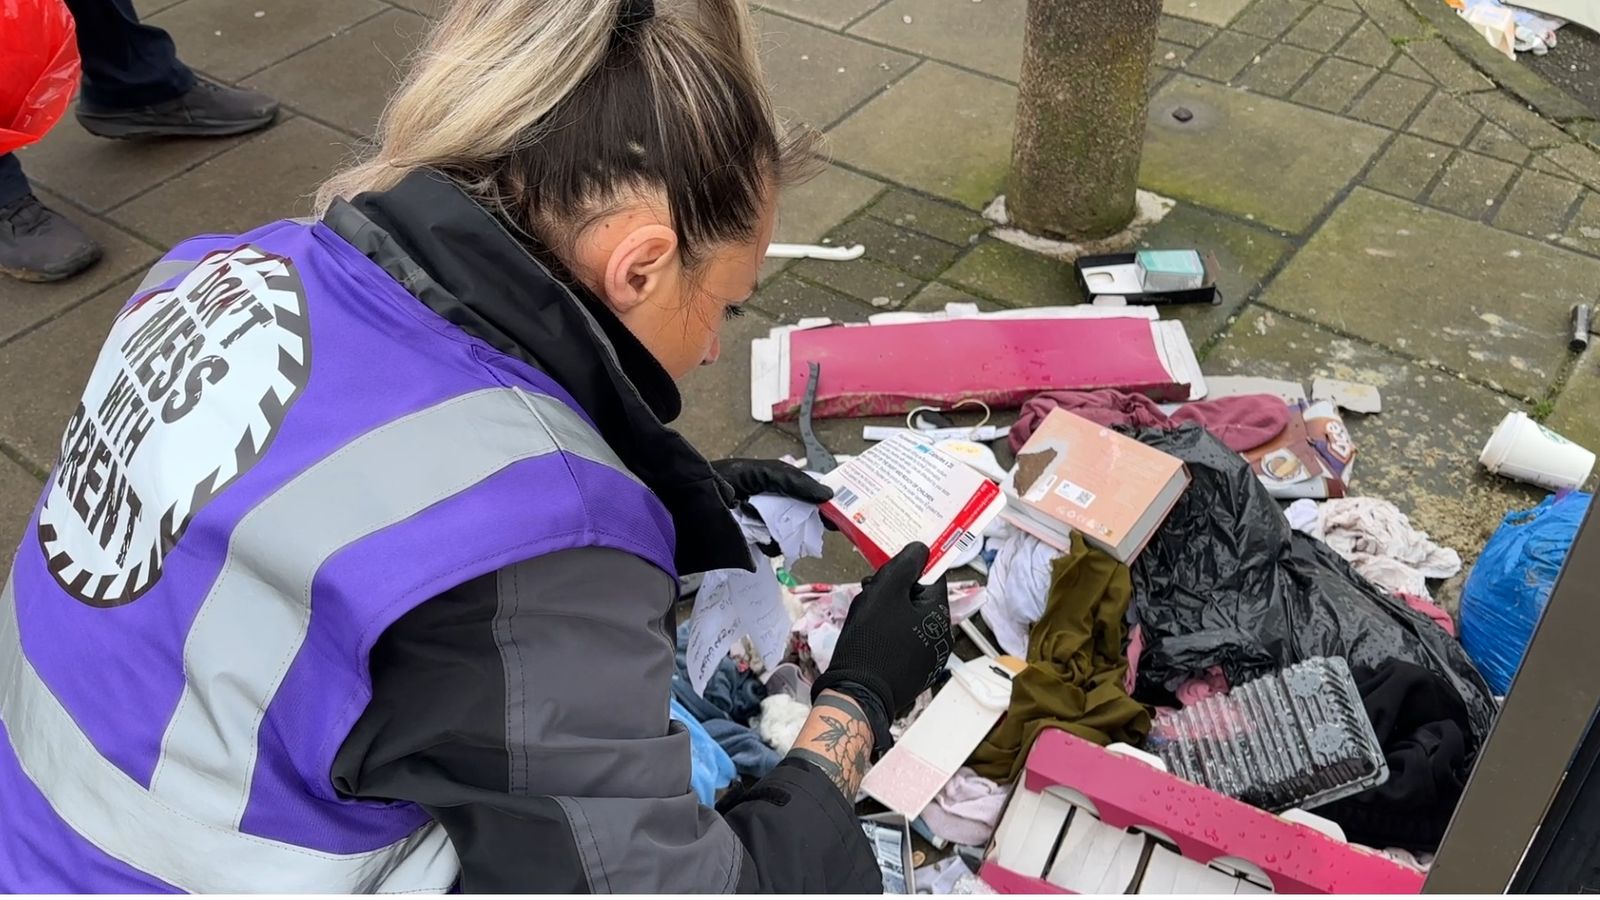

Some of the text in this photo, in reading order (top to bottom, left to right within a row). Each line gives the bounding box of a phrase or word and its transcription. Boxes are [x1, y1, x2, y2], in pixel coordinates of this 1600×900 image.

[121, 296, 230, 424] MESS
[187, 262, 275, 349] DON'T
[98, 368, 156, 468] WITH
[58, 400, 143, 569] BRENT
